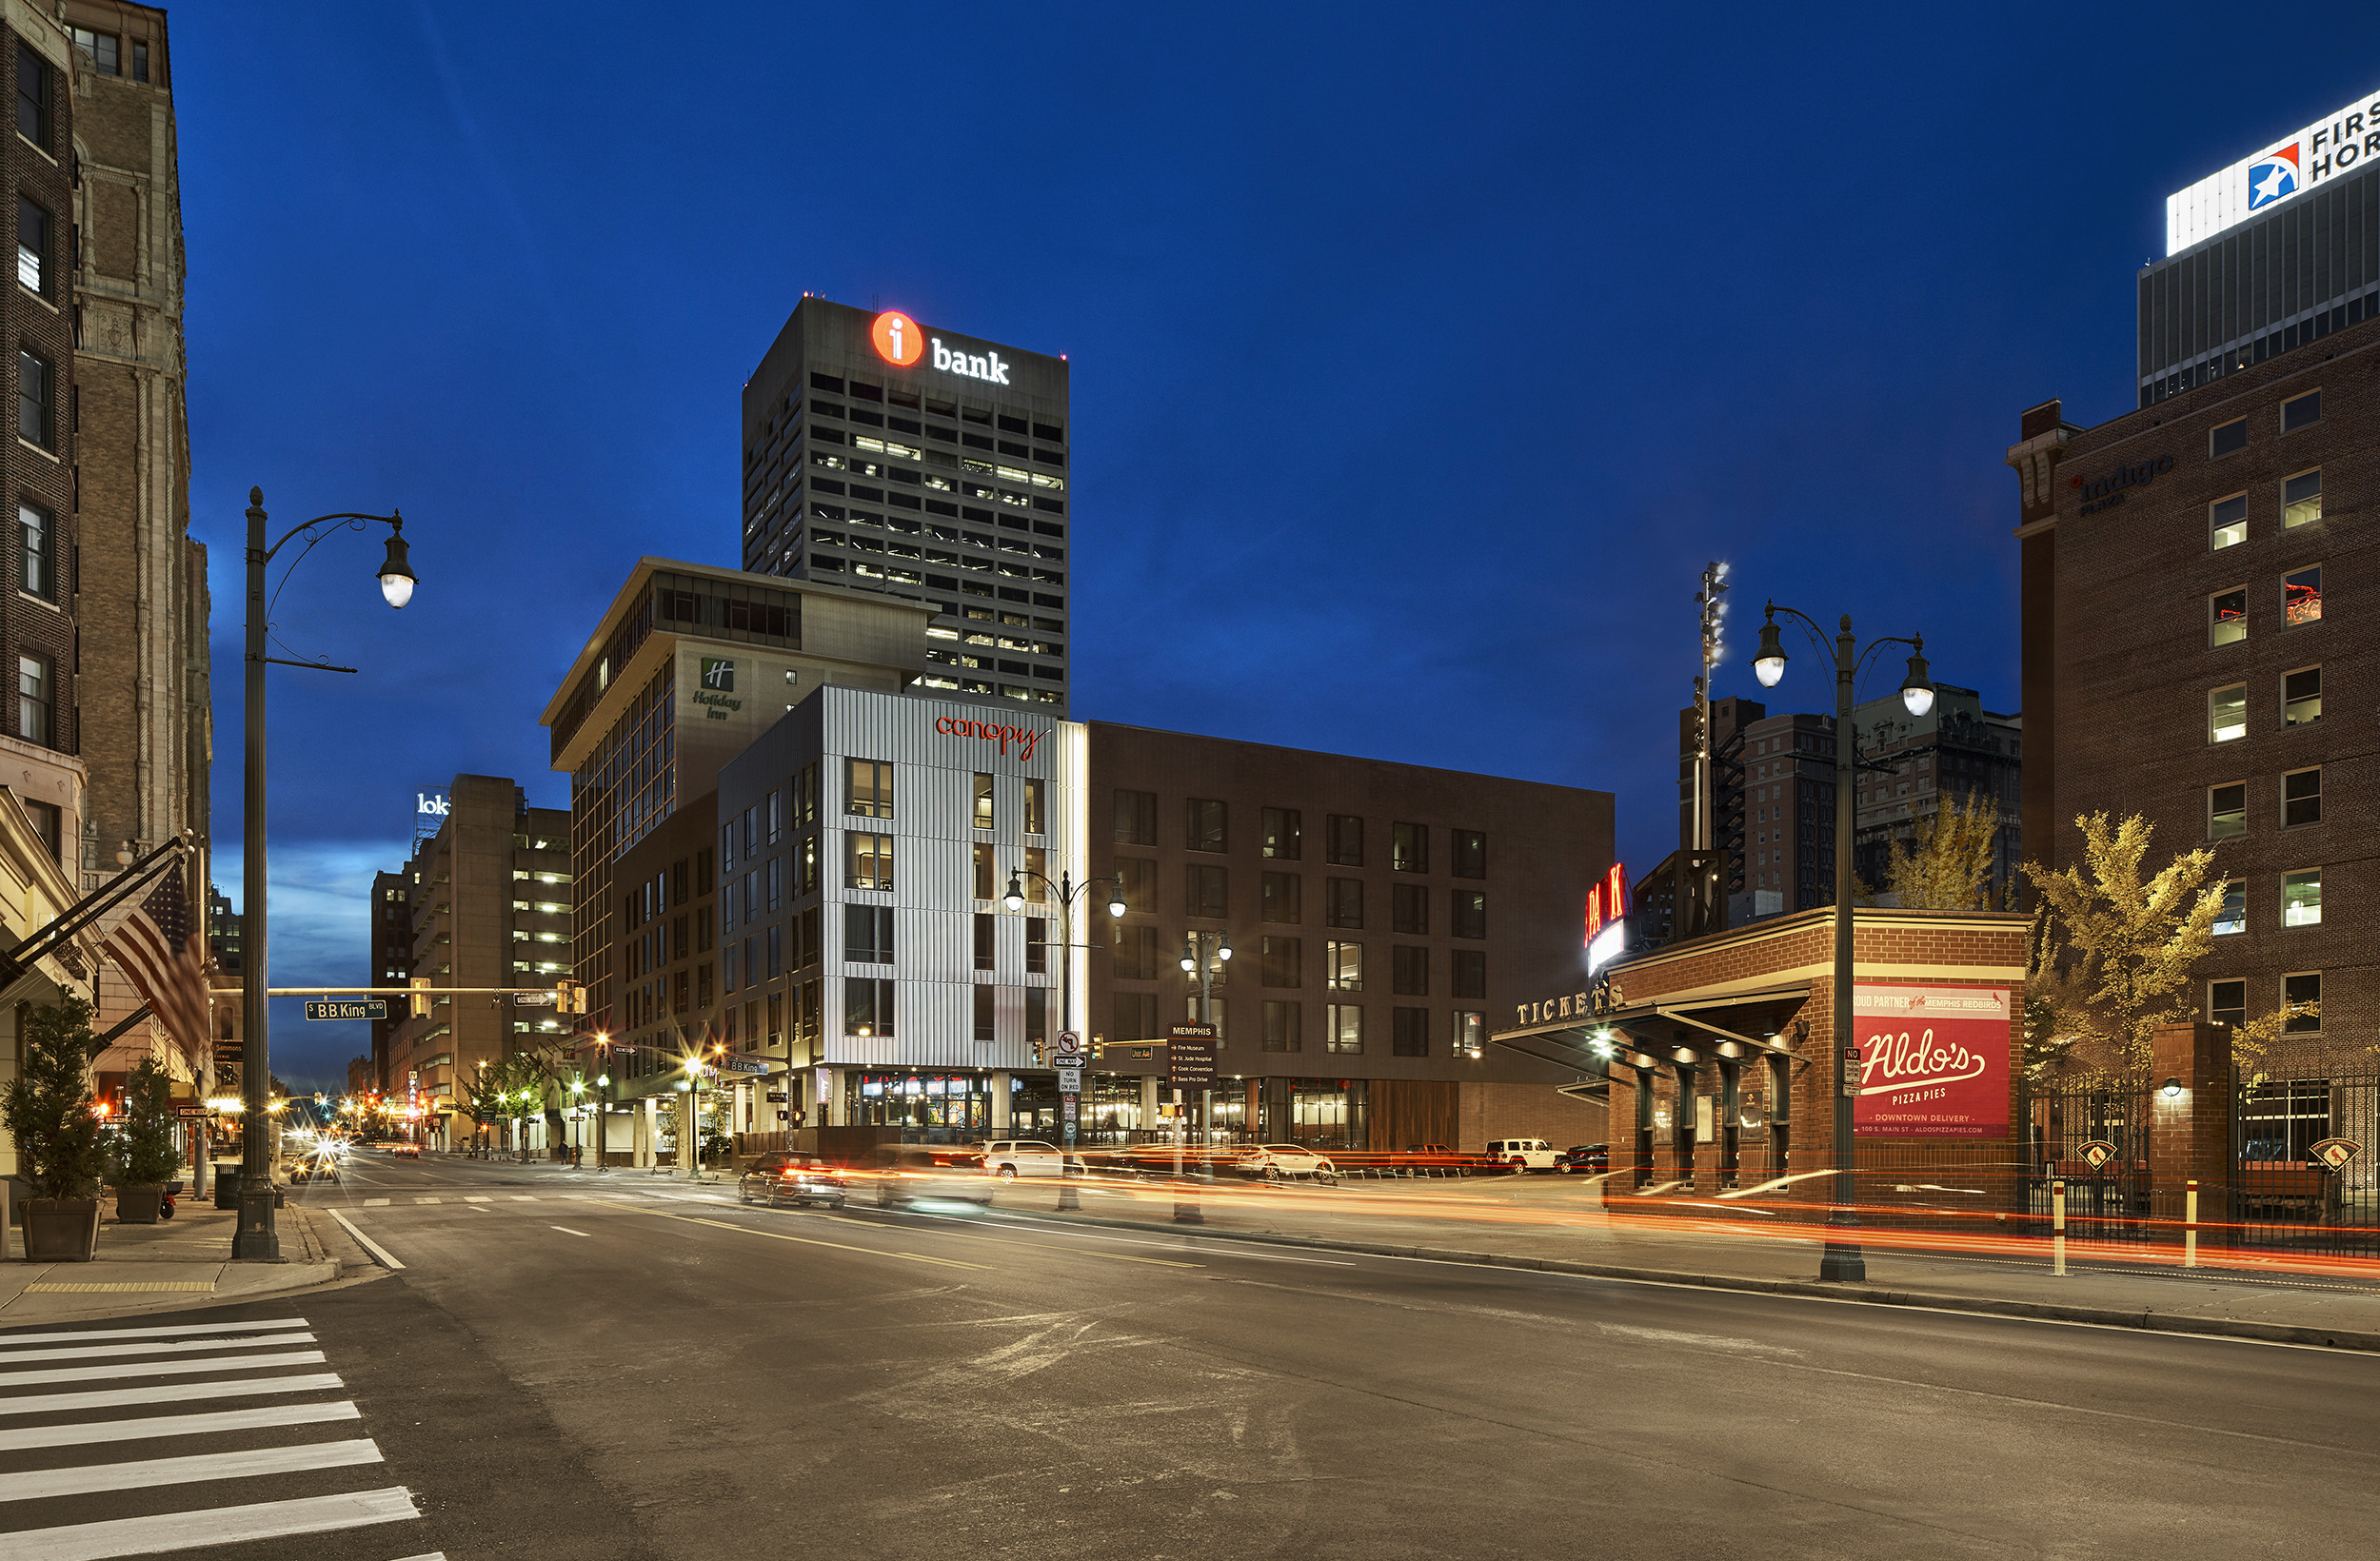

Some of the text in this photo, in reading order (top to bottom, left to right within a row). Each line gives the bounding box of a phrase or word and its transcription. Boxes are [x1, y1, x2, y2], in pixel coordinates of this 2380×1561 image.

[2312, 101, 2380, 156] FIRS
[2312, 130, 2380, 183] HOR
[932, 337, 1009, 385] bank
[2072, 455, 2173, 503] indigo
[693, 690, 742, 712] Holiday
[706, 705, 727, 721] Inn
[936, 717, 1052, 762] canopy
[417, 793, 451, 816] lok
[1588, 862, 1622, 941] PAK
[308, 1003, 314, 1012] S
[340, 1003, 366, 1018] King
[1517, 985, 1624, 1025] TICKETS
[1874, 996, 1909, 1008] PARTNER
[1925, 999, 1961, 1008] MEMPHIS
[1962, 1000, 2001, 1009] REDBIRDS
[1173, 1027, 1211, 1036] MEMPHIS
[1848, 1050, 1858, 1058] NO
[1860, 1028, 1971, 1085] Aldo's
[1893, 1088, 1946, 1105] PIZZA PIES
